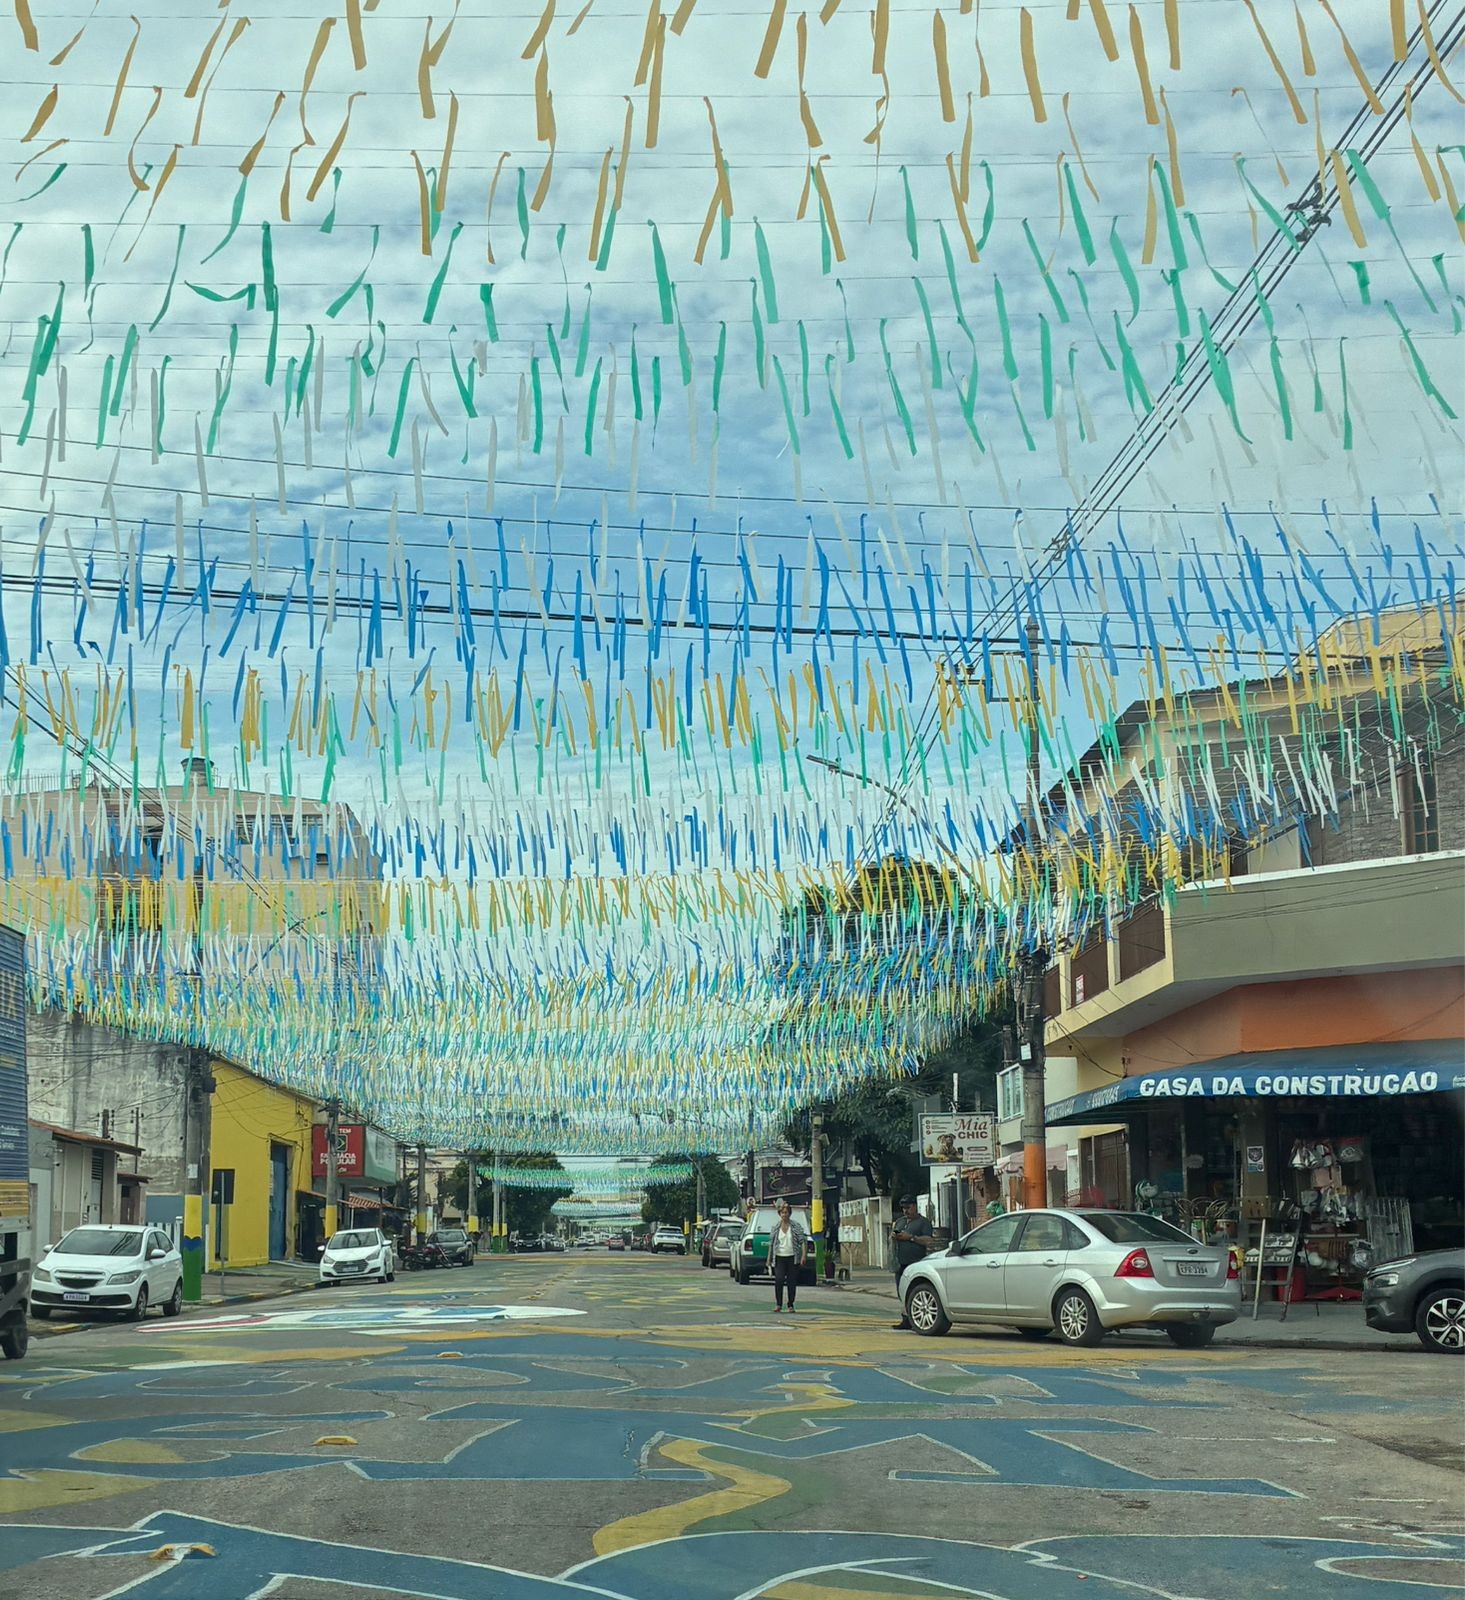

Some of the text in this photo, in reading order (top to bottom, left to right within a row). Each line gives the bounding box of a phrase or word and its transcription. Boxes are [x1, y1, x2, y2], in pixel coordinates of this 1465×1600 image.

[1139, 1077, 1205, 1097] CASA
[1212, 1076, 1247, 1096] DA
[954, 1117, 988, 1131] Mia
[958, 1131, 988, 1139] CHIC
